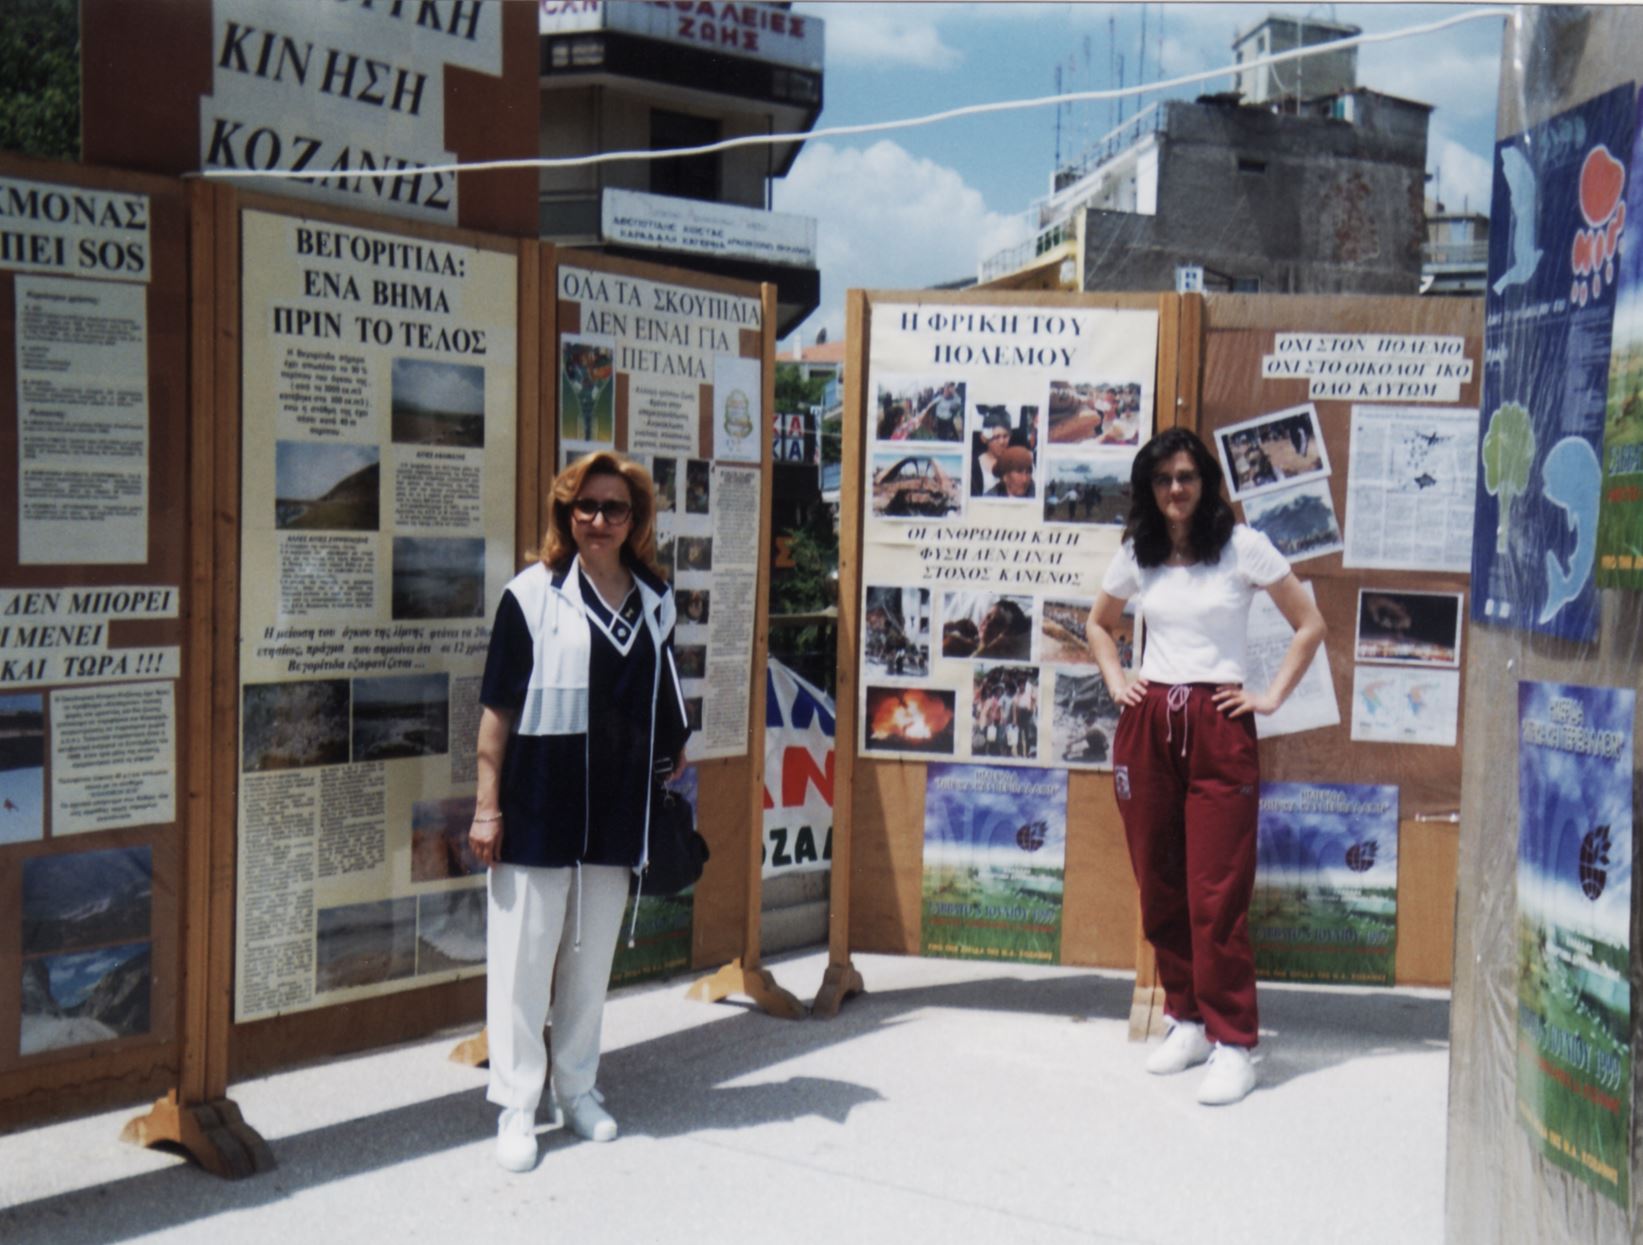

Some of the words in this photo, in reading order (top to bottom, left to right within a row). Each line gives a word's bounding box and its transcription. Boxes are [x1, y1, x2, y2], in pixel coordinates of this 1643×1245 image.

[218, 21, 429, 116] ΚΙΝΗΣΗ
[205, 117, 457, 211] ΚΟΖΑΝΗΣ
[78, 238, 145, 272] SOS
[296, 228, 466, 278] ΒΕΓΟΡΙΤΙΔΑ:
[303, 270, 361, 302] ΕΝΑ
[372, 281, 451, 315] ΒΗΜΑ
[614, 280, 643, 308] ΤΑ
[272, 306, 343, 340] ΠΡΙΝ
[355, 317, 394, 347] ΤΟ
[401, 320, 487, 355] ΤΕΛΟΣ
[586, 310, 628, 338] ΔΕΝ
[635, 317, 690, 347] ΕΙΝΑΙ
[698, 328, 730, 352] ΓΙΑ
[901, 312, 919, 331] Η
[927, 312, 1018, 335] ΦΡΙΚΗ
[1025, 315, 1088, 337] ΤΟΥ
[931, 344, 1078, 368] ΠΟΛΕΜΟΥ
[1279, 337, 1313, 352] ΟΧΙ
[1315, 337, 1367, 353] ΣΤΟΝ
[1376, 339, 1463, 356] ΠΟΛΕΜΟ
[621, 346, 708, 379] ΠΕΤΑΜΑ
[1267, 359, 1301, 374] ΟΧΙ
[1304, 359, 1341, 374] ΣΤΟ
[907, 527, 928, 541] ΟΙ
[932, 527, 1027, 543] ΑΝΘΡΩΠΟΙ
[920, 547, 968, 562] ΦΥΣΗ
[1012, 550, 1064, 566] ΕΙΝΑΙ
[922, 566, 992, 581] ΣΤΟΧΟΣ
[998, 569, 1083, 587] ΚΑΝΕΝΟΣ
[4, 591, 59, 616] ΔΕΝ
[67, 590, 172, 615] ΜΠΟΡΕΙ
[0, 658, 47, 682] ΚΑΙ
